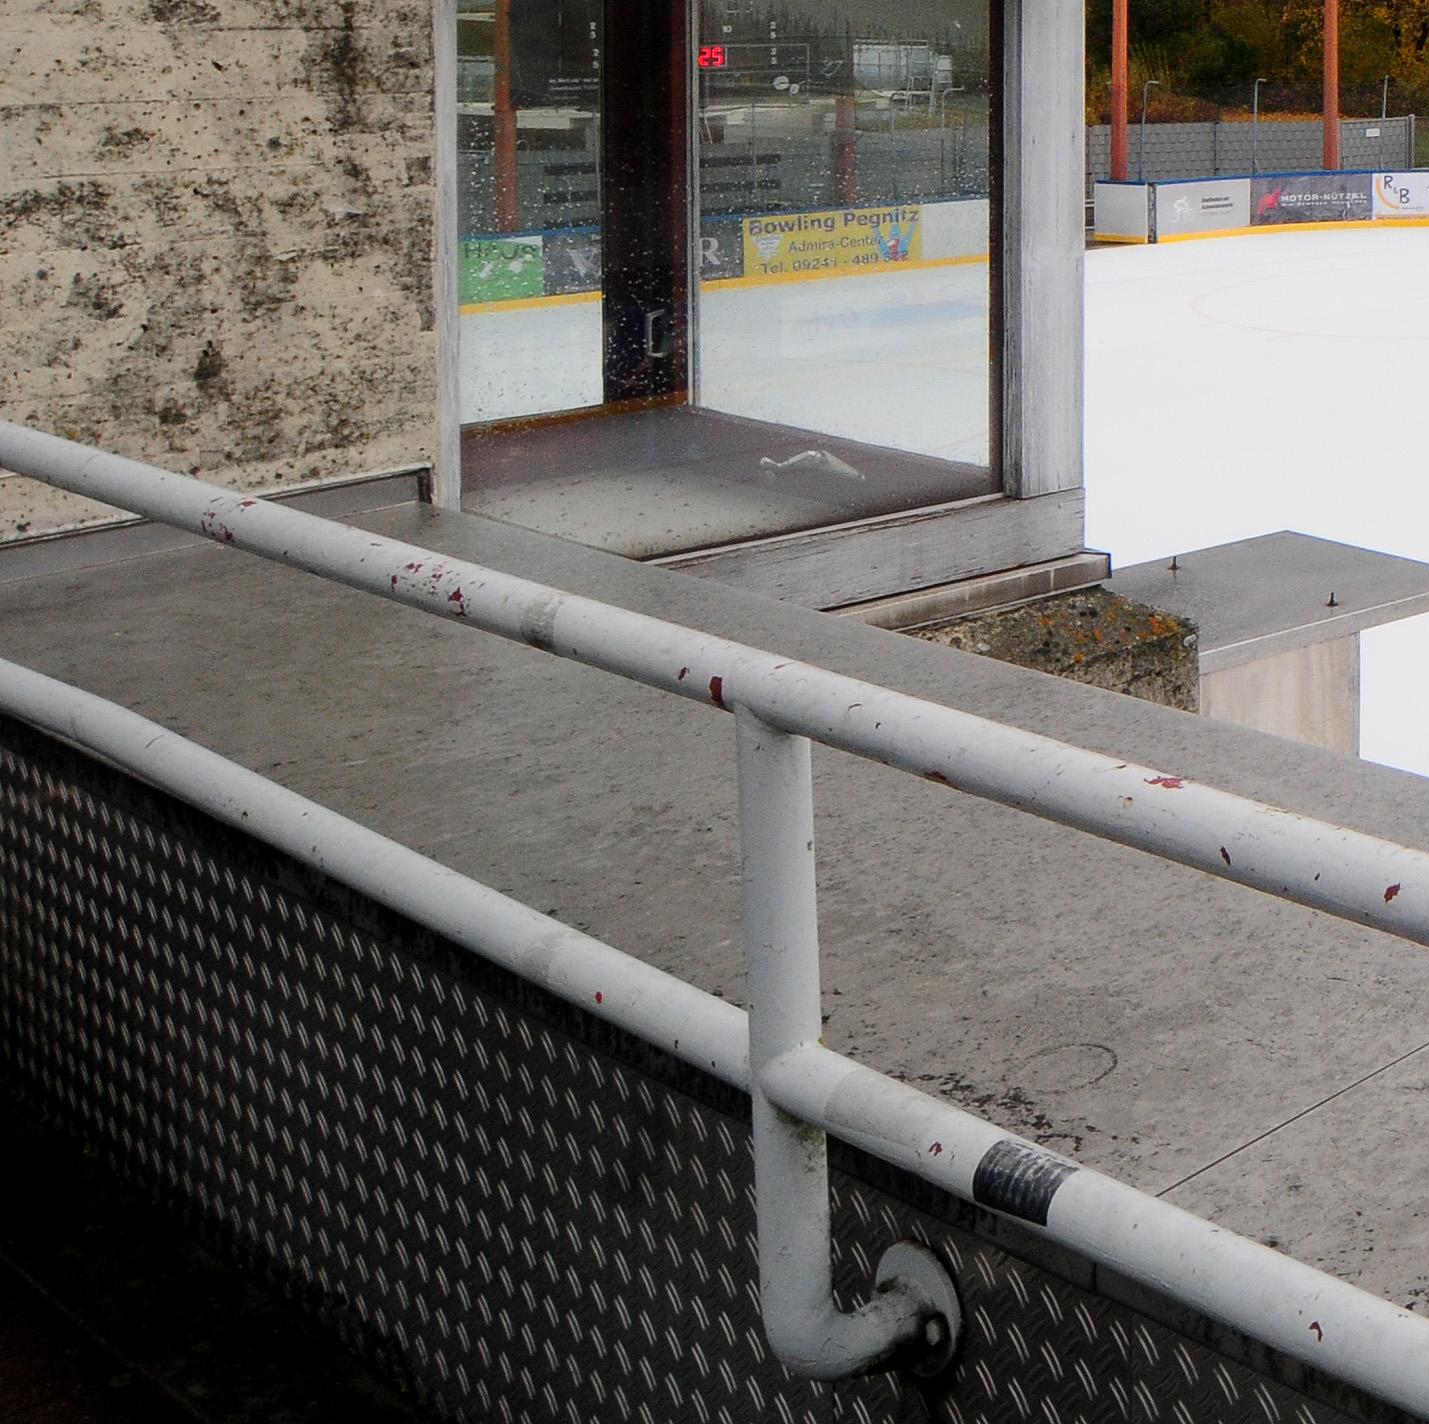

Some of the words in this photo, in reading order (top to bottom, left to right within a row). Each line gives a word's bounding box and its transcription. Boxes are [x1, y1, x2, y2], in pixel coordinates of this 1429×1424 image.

[698, 47, 725, 68] 25
[1281, 191, 1368, 203] MOTOR-NÜTZEL
[749, 215, 835, 235] Bowling
[843, 208, 920, 228] Pegnitz
[760, 262, 788, 274] Tel.
